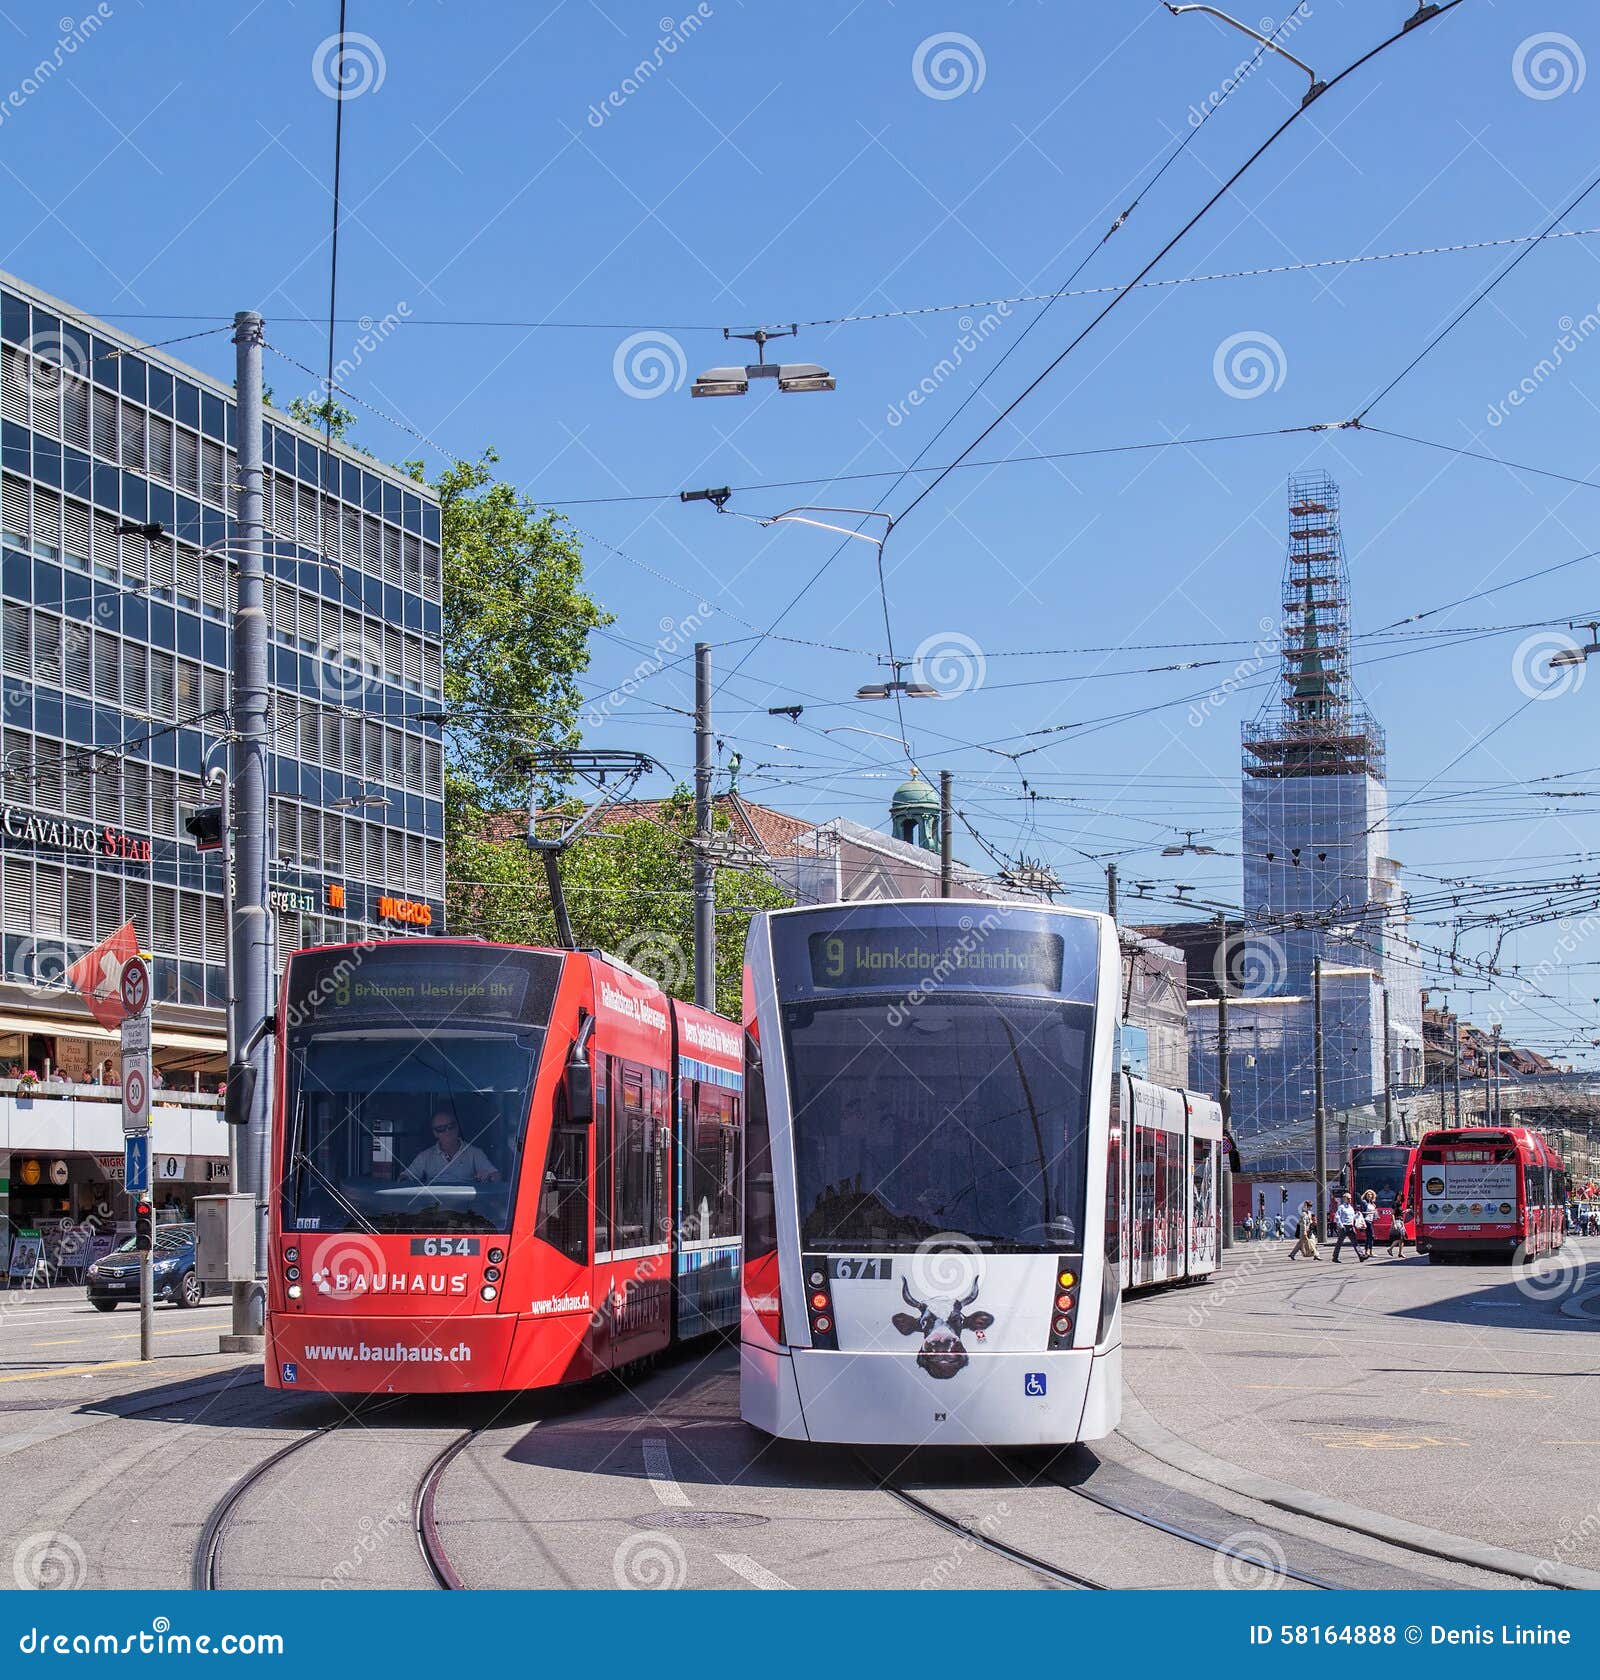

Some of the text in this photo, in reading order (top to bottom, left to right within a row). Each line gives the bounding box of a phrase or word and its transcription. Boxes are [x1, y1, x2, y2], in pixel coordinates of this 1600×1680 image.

[3, 806, 151, 863] CAVALLO STAR
[379, 896, 432, 926] MIGROS
[825, 938, 1038, 977] 9 Wankdorf Bahnhof
[335, 976, 514, 1006] 8 Brünnen Westside Bhf
[129, 1059, 141, 1068] ZONE
[131, 1085, 140, 1100] 30
[423, 1238, 471, 1257] 654
[835, 1258, 882, 1280] 671
[335, 1272, 468, 1292] BAUHAUS
[531, 1292, 590, 1315] www.bauhaus.ch
[304, 1342, 471, 1362] www.bauhaus.ch
